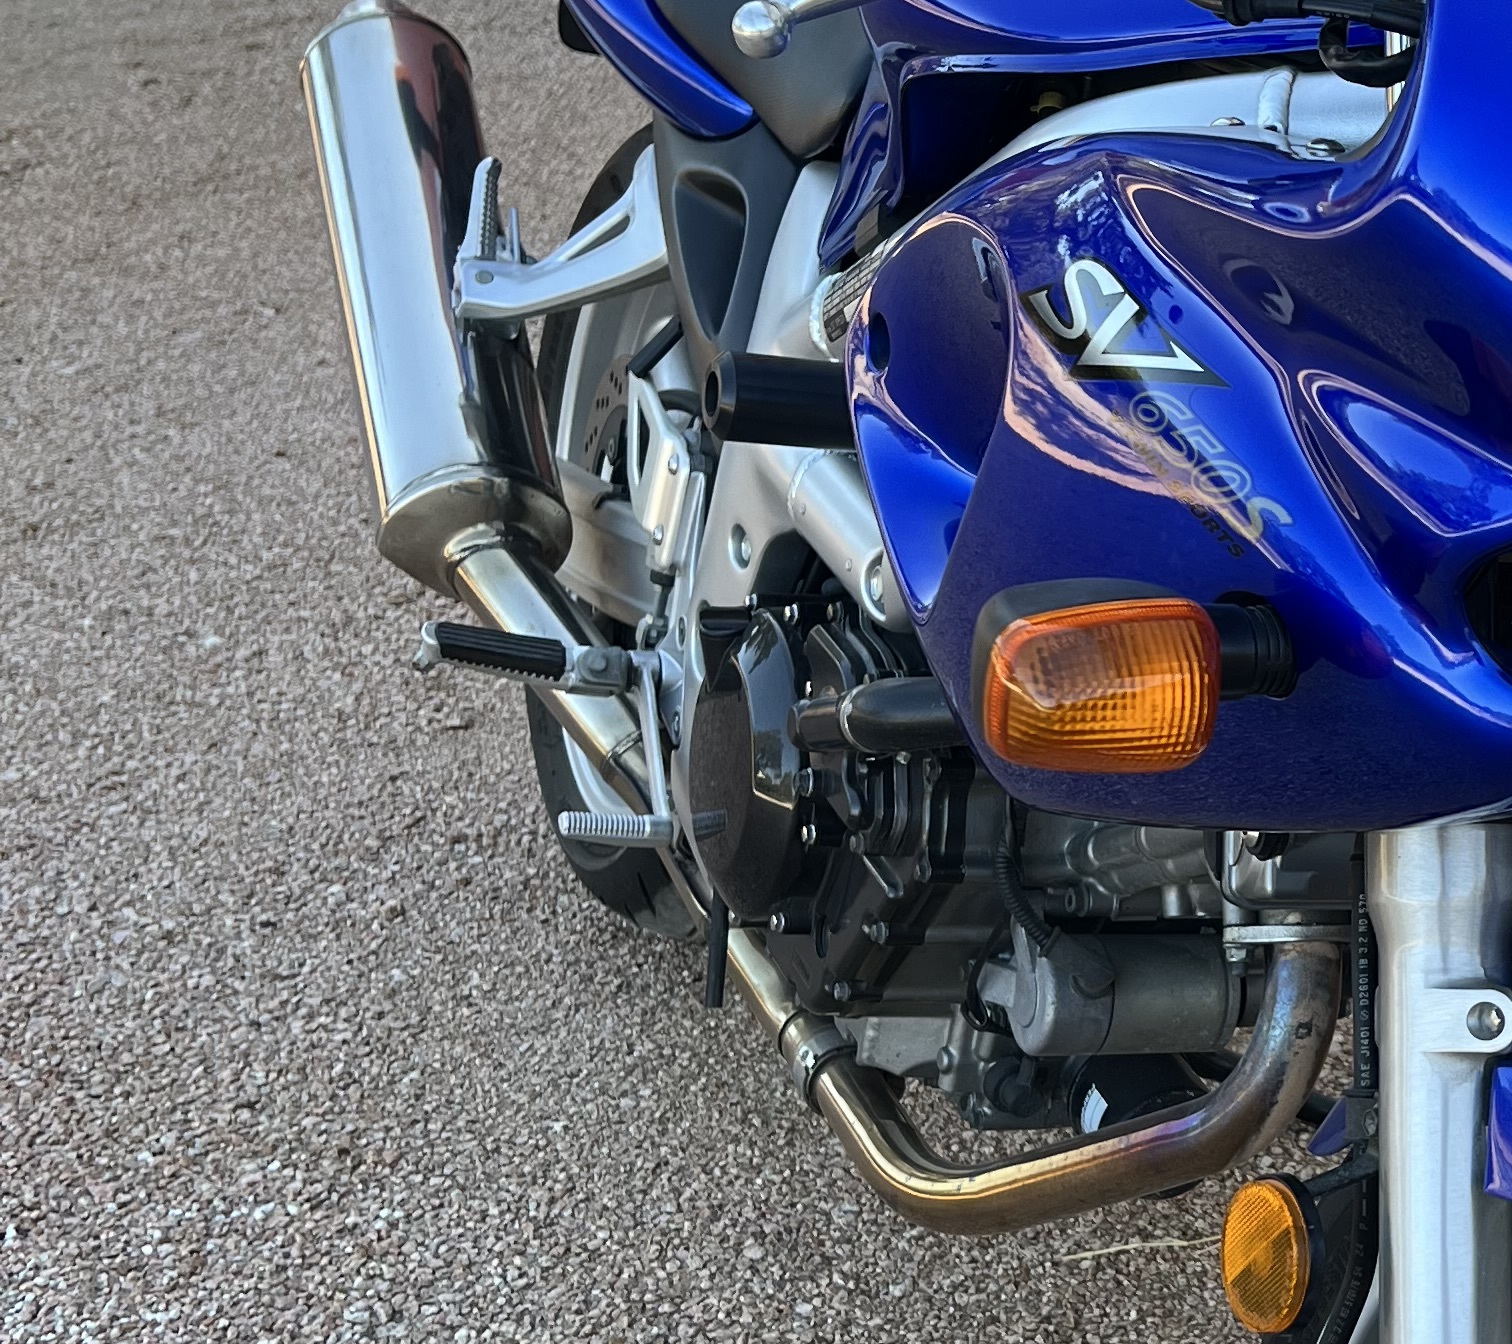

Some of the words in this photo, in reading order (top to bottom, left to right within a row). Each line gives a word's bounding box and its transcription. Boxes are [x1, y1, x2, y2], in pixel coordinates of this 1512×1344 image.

[1022, 258, 1214, 378] SV
[1129, 389, 1294, 544] 650S
[1167, 480, 1247, 558] SPORTS
[1359, 1026, 1371, 1057] J1401
[1359, 1063, 1371, 1087] SAE
